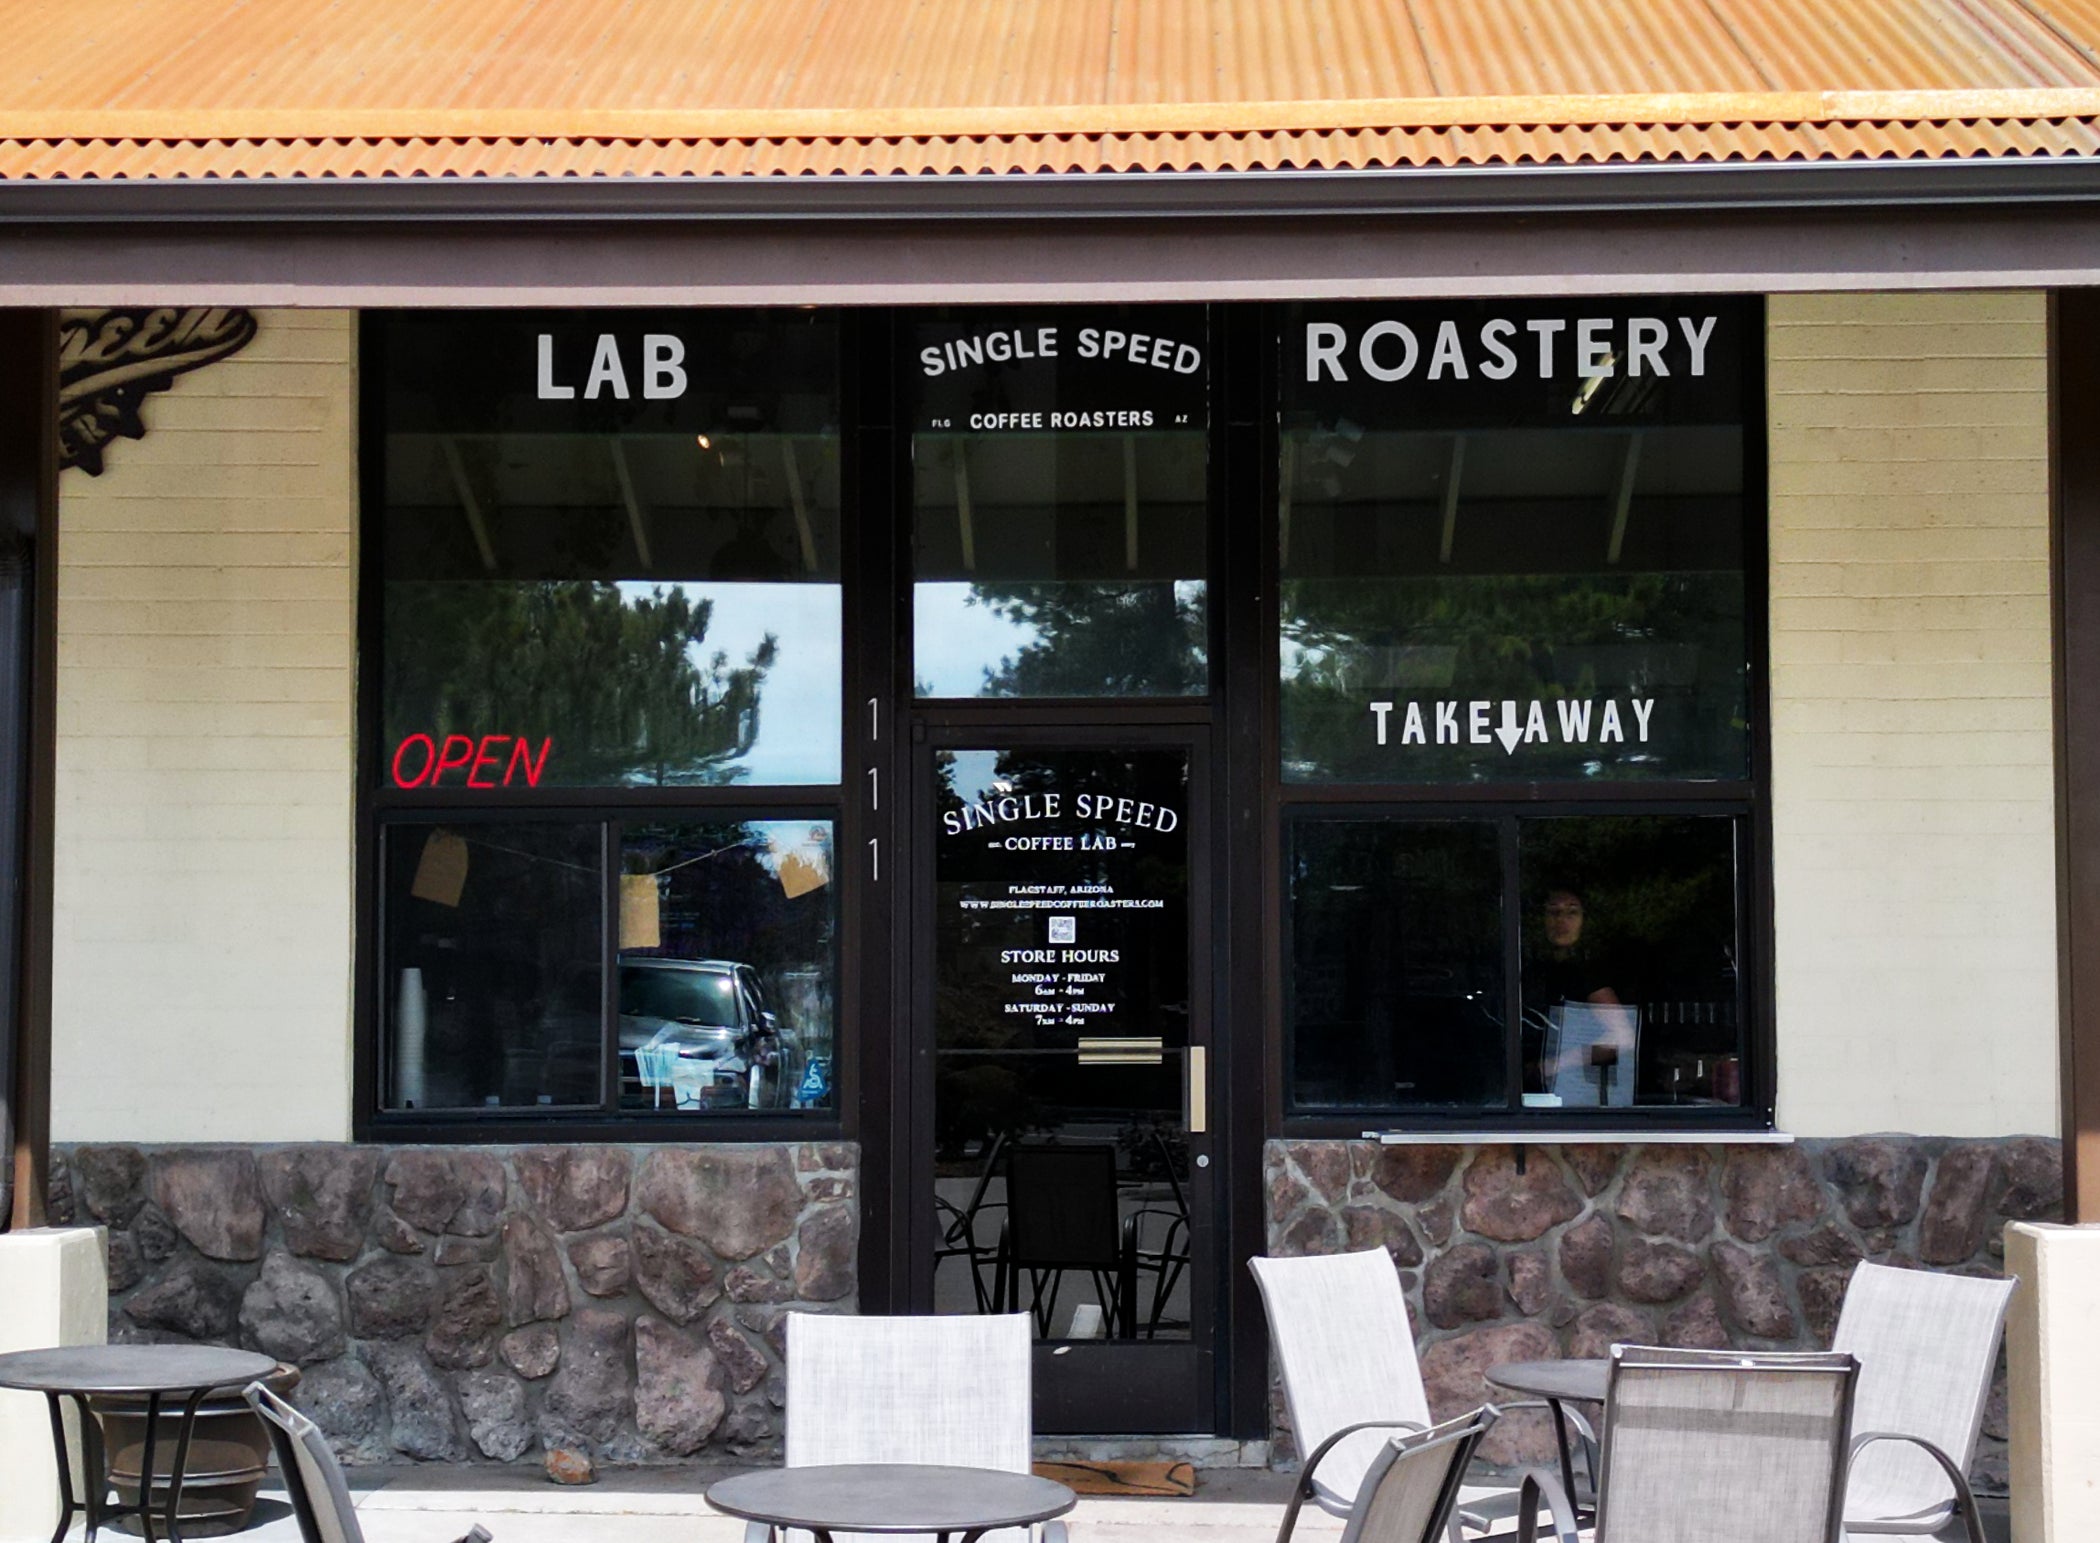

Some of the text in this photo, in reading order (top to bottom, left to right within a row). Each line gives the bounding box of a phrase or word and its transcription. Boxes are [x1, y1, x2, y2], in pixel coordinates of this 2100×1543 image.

[920, 328, 1201, 376] SINGLE SPEED
[1306, 316, 1718, 382] ROASTERY
[537, 334, 688, 400] LAB
[931, 418, 951, 428] FLG
[970, 410, 1154, 429] COFFEE ROASTERS
[1174, 414, 1188, 423] AZ
[1369, 699, 1655, 745] TAKE AWAY
[391, 732, 552, 789] OPEN
[943, 793, 1178, 835] SINGLE SPEED
[1004, 836, 1117, 851] COFFEE LAB
[1008, 885, 1114, 895] FLAGSTAFF, ARIZONA
[1000, 949, 1120, 964] STORE HOURS
[1011, 973, 1060, 984] MONDAY
[1067, 973, 1106, 983] FRIDAY
[1004, 1003, 1063, 1013] SATURDAY
[1071, 1003, 1116, 1013] SUNDAY
